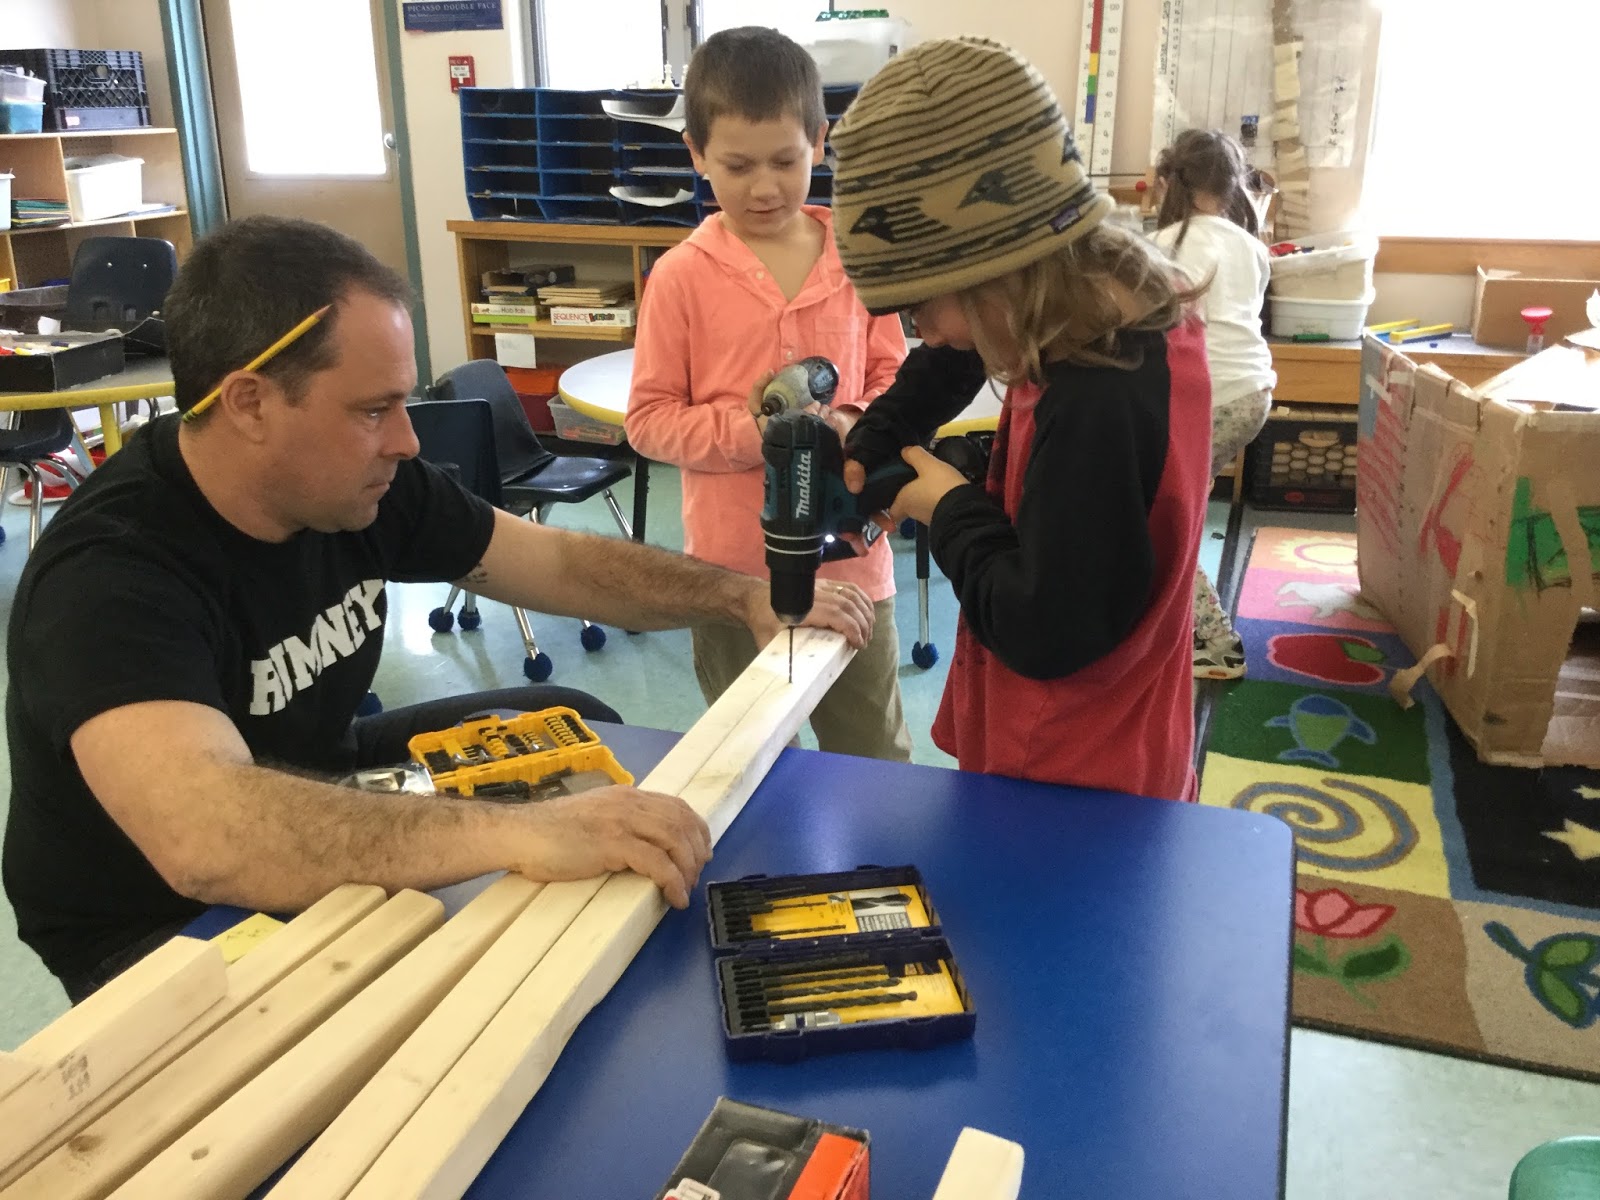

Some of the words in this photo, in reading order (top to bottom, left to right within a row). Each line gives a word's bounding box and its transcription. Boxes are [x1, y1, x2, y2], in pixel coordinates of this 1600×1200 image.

[407, 4, 441, 12] PICASSO
[443, 3, 475, 11] DOUBLE
[477, 2, 497, 10] FACE
[553, 313, 589, 321] SEQUENCE
[795, 450, 812, 519] makita
